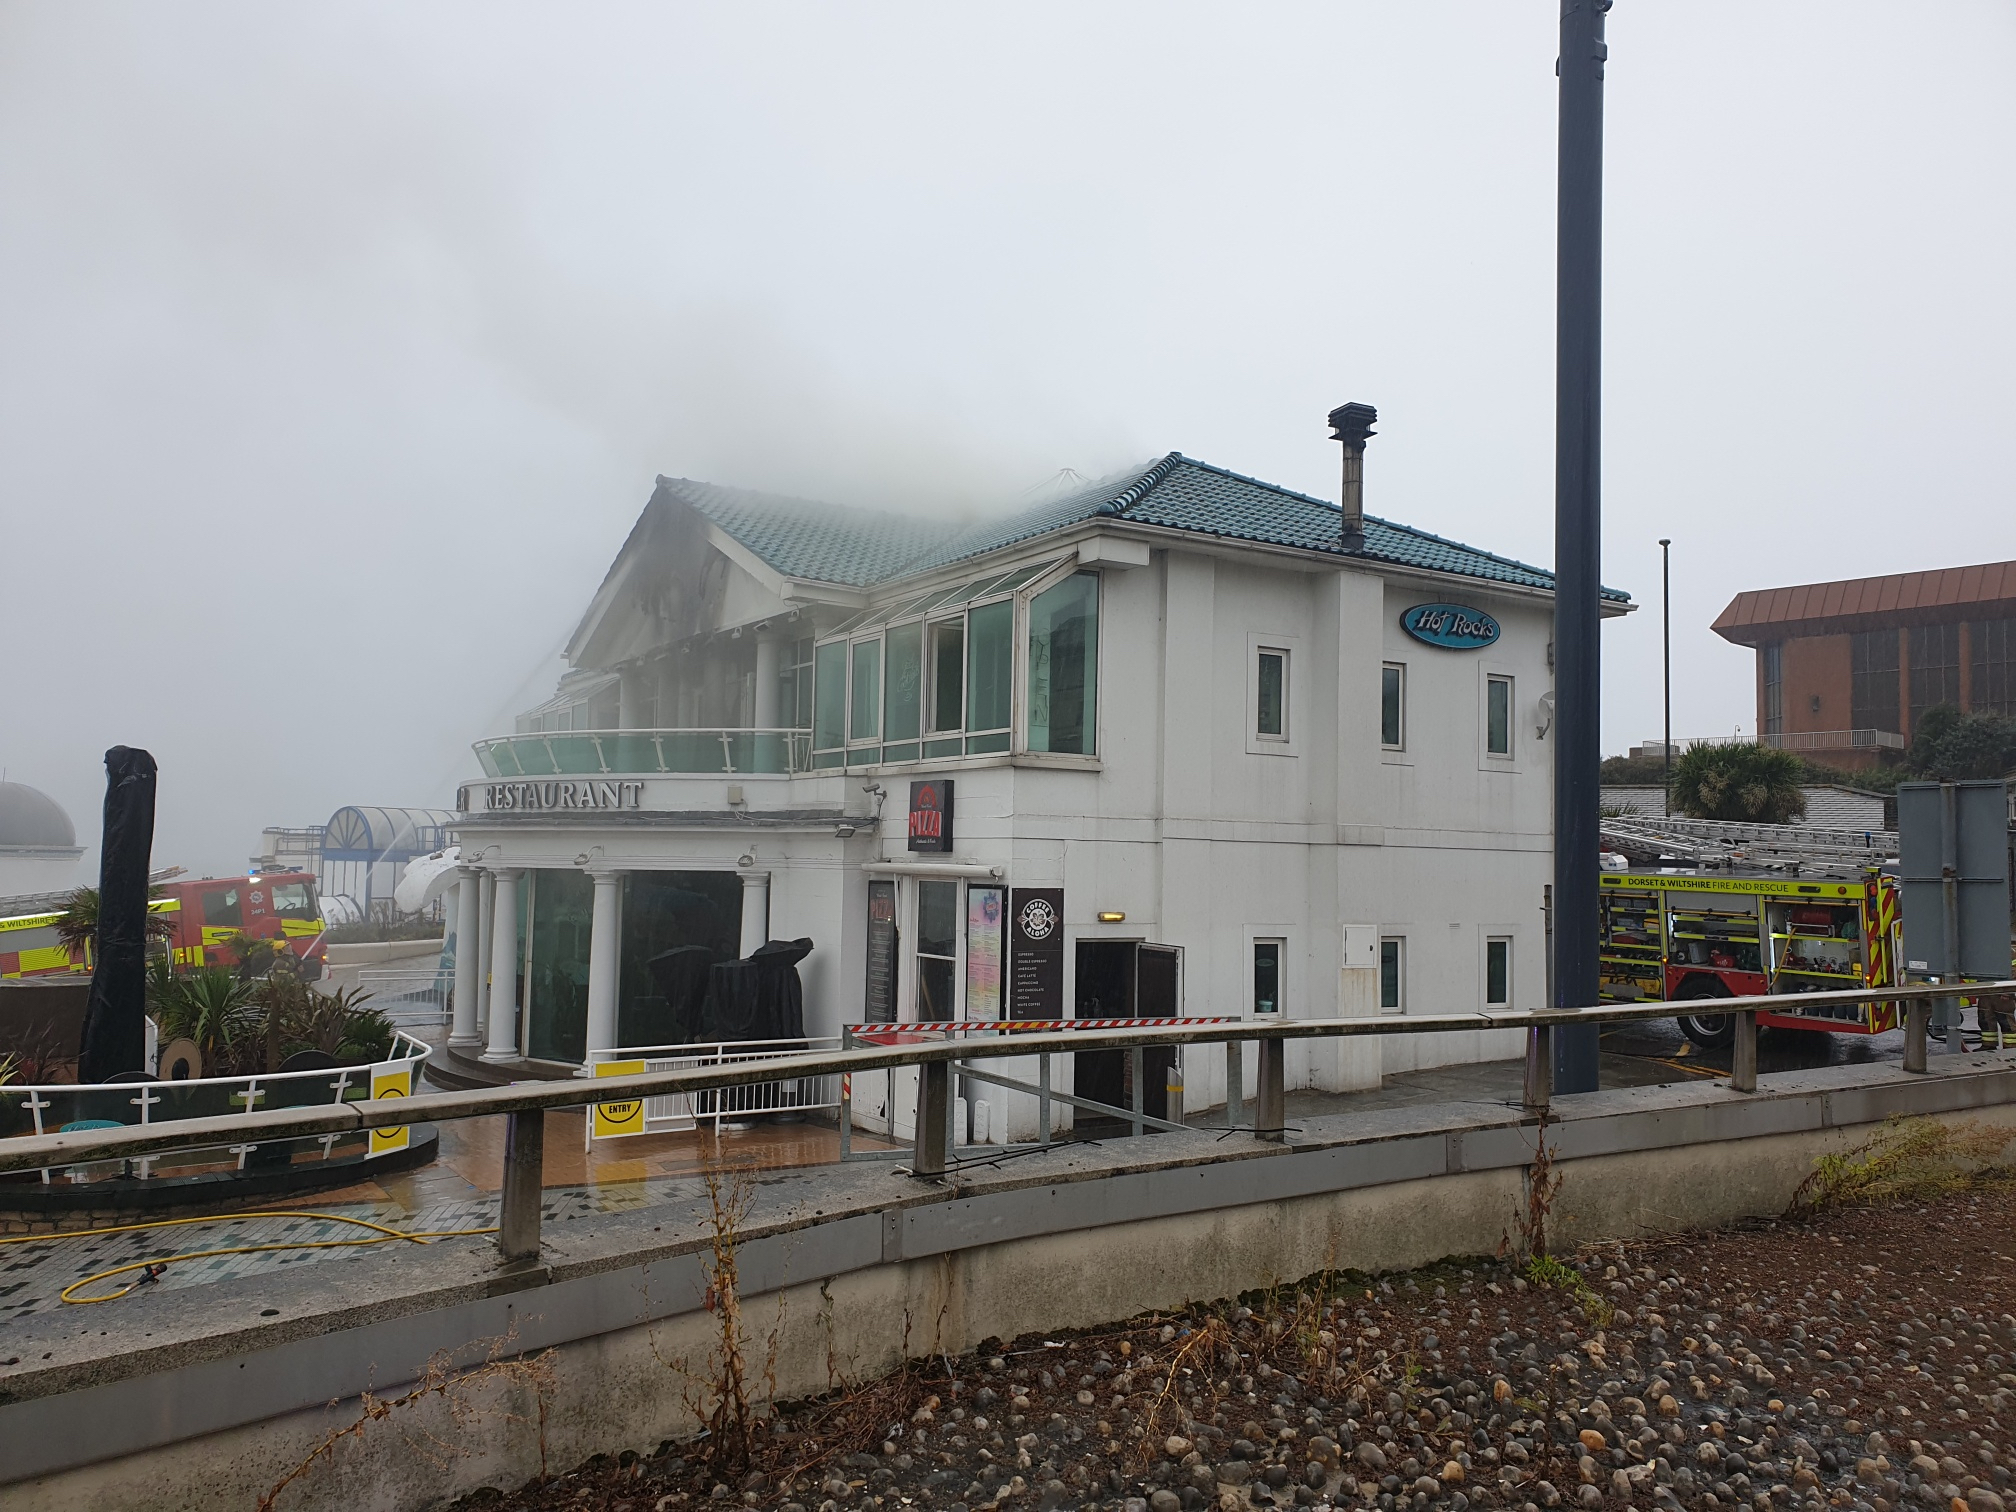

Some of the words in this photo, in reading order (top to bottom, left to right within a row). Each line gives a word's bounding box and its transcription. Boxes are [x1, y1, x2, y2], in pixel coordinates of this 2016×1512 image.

[1417, 611, 1450, 632] Hot
[1451, 613, 1494, 637] Rocks
[484, 782, 643, 810] RESTAURANT
[909, 810, 943, 838] PIZZA
[1628, 878, 1659, 887] DORSET
[1660, 879, 1666, 887] &
[1667, 880, 1711, 889] WILTSHIRE
[1712, 881, 1731, 890] FIRE
[1732, 883, 1752, 891] AND
[1754, 883, 1789, 892] RESCUE
[1026, 902, 1050, 914] COFFEE
[7, 917, 50, 928] WILTSHIRE
[1026, 926, 1050, 937] ALOHA
[609, 1104, 631, 1113] ENTRY
